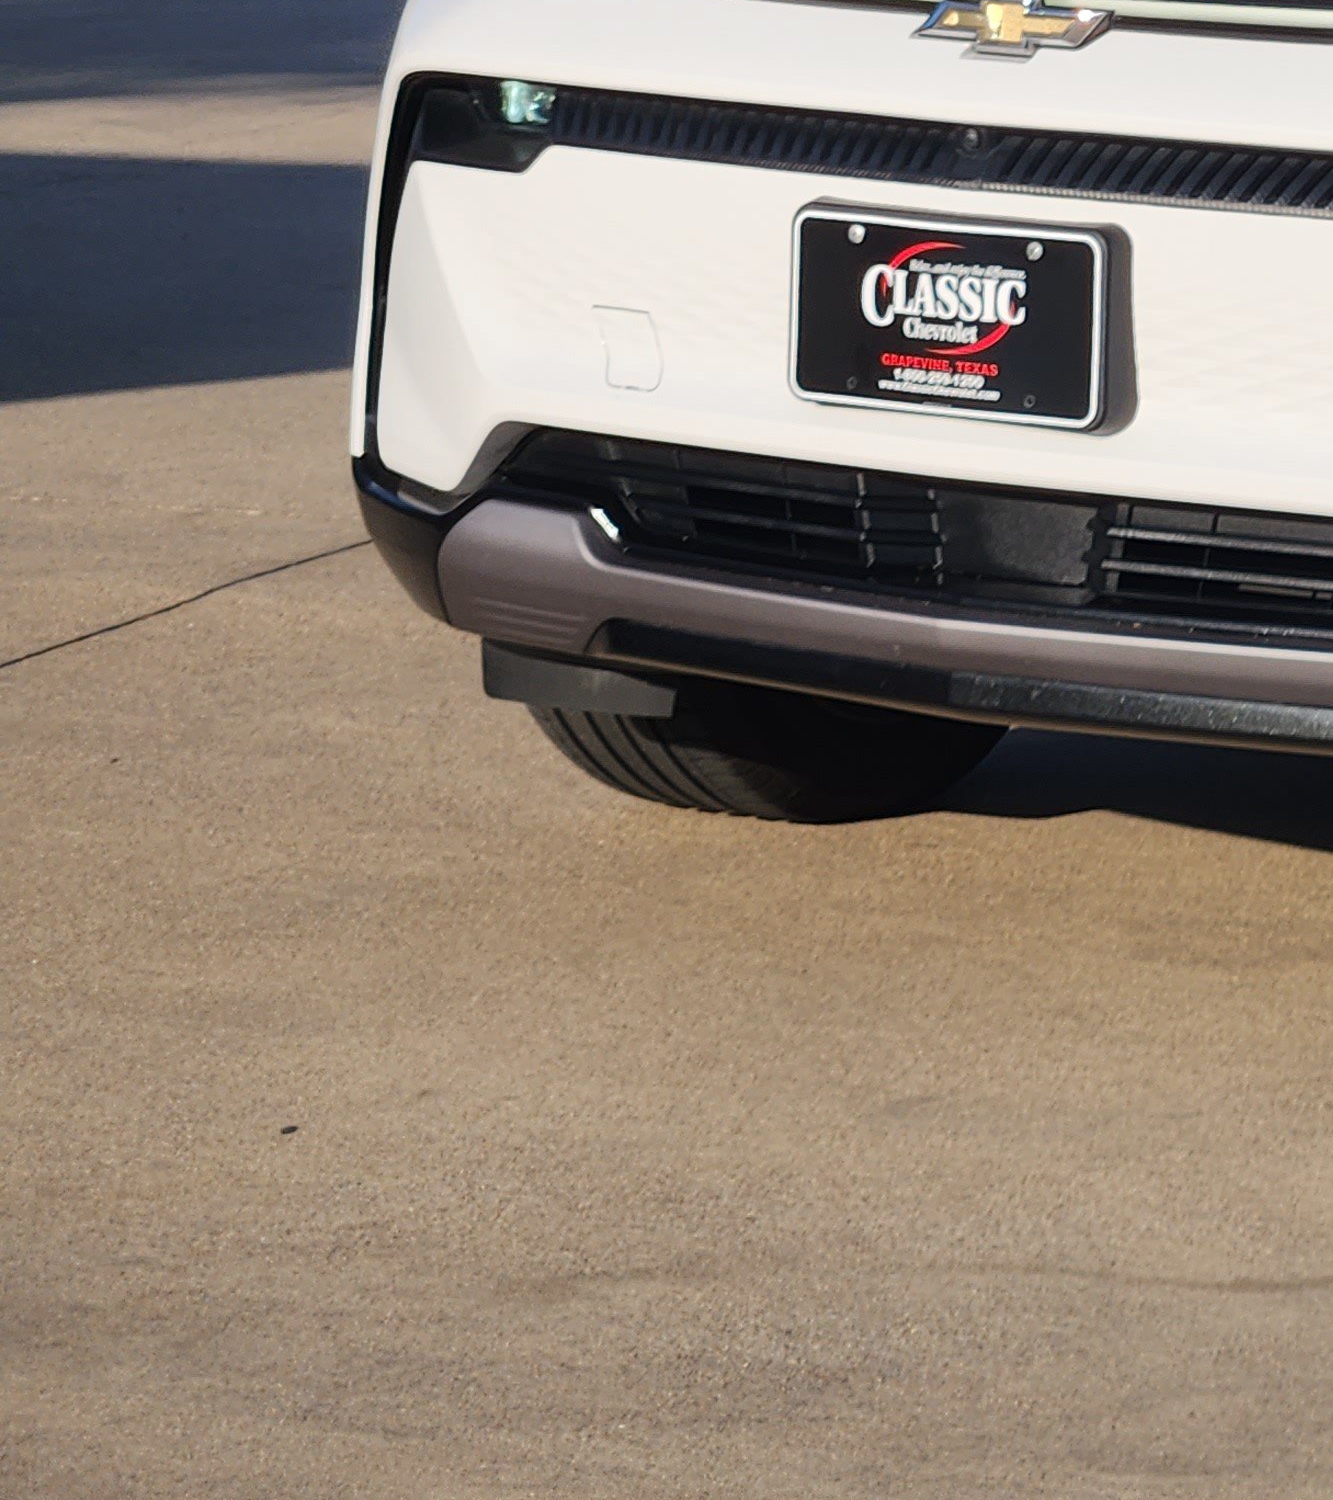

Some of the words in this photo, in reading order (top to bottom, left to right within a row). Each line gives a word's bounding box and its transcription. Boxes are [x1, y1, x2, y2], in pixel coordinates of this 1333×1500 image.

[861, 263, 1027, 326] CLASSIC
[902, 317, 978, 344] Chevrolet
[955, 360, 999, 376] TEXAS
